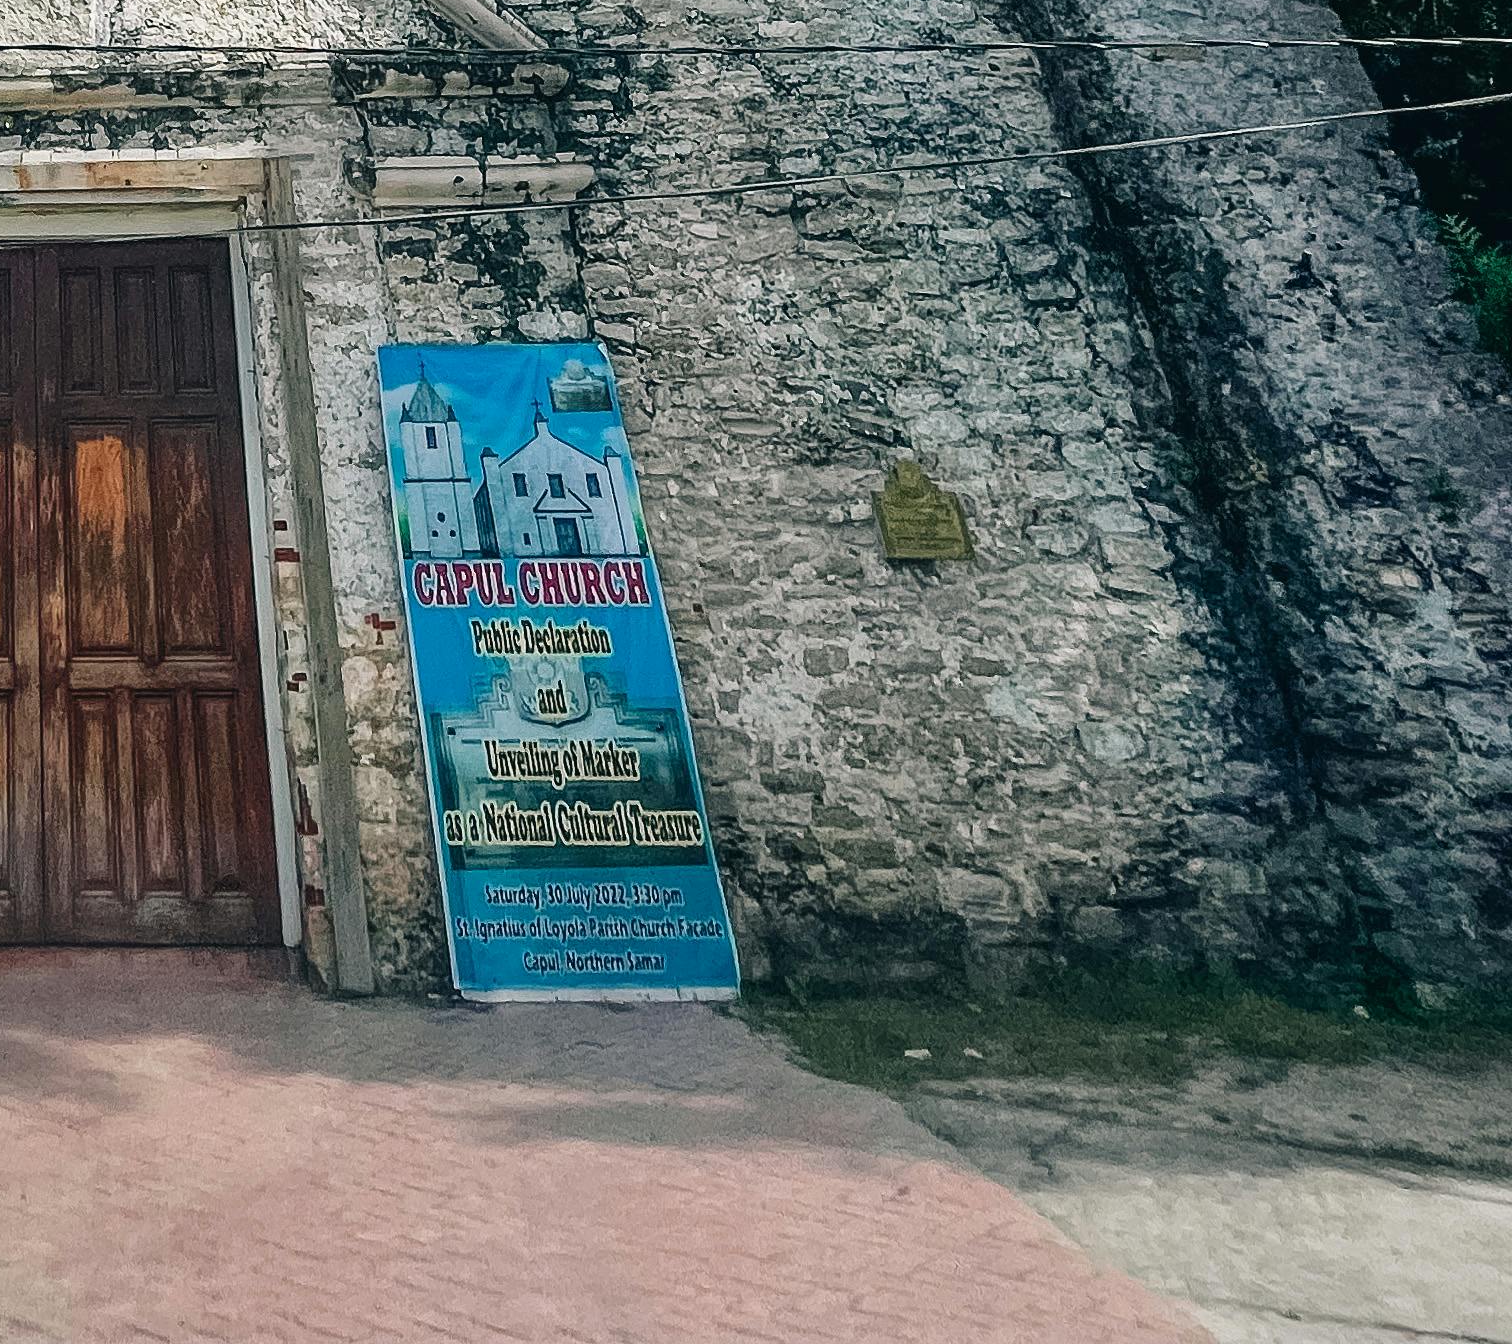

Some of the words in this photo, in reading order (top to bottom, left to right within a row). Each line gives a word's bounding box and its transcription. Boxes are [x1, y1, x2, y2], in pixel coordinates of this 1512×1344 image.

[413, 561, 516, 606] CAPUL
[518, 560, 651, 606] CHURCH
[471, 619, 522, 654] Public
[521, 619, 612, 655] Declaration
[537, 679, 568, 715] and
[484, 740, 565, 787] Unveiling
[563, 740, 580, 777] of
[579, 740, 639, 778] Marker
[445, 812, 463, 843] as
[468, 812, 480, 843] a
[483, 802, 555, 843] National
[557, 802, 629, 843] Cultural
[628, 802, 703, 843] Treasure
[485, 885, 546, 910] Saturday,
[547, 885, 563, 905] 30
[566, 884, 591, 912] July
[632, 884, 660, 905] 3:30
[662, 889, 684, 911] pm
[475, 918, 527, 944] Ignatius
[529, 918, 543, 938] of
[544, 918, 587, 944] Loyola
[588, 917, 628, 938] Parish
[630, 918, 676, 938] Church
[677, 918, 723, 938] Facade
[566, 952, 625, 972] Northern
[626, 951, 665, 971] Samar
